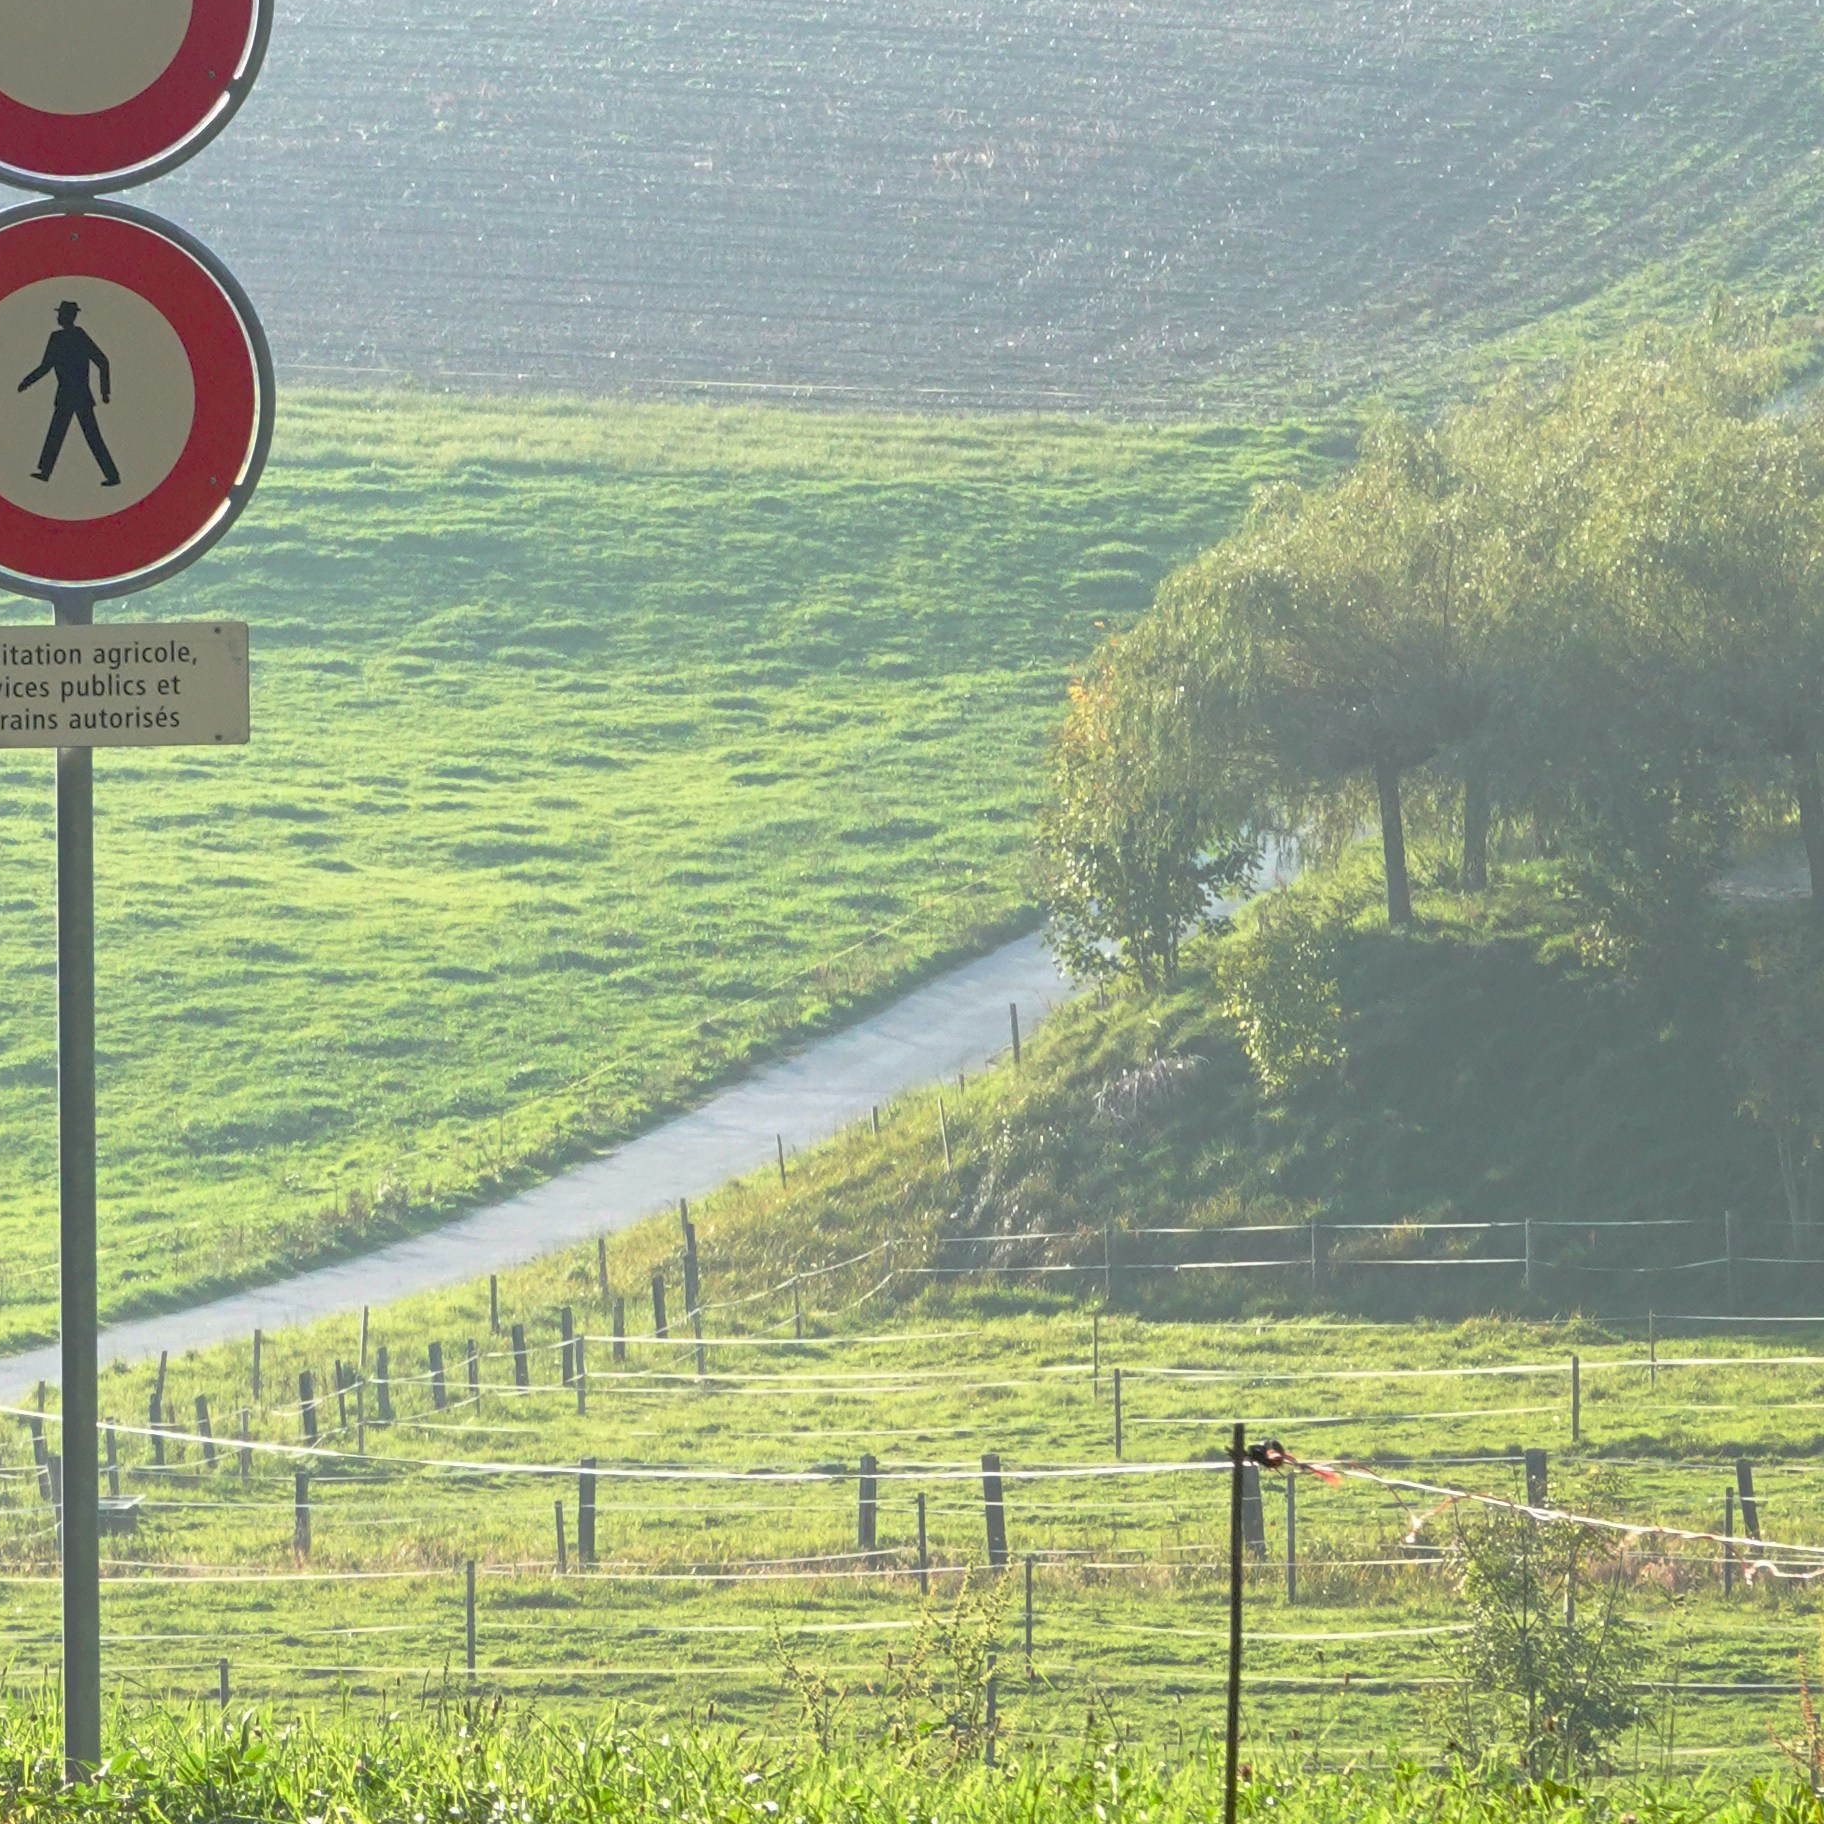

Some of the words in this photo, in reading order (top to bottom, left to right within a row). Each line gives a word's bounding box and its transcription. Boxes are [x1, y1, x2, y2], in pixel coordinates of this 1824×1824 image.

[93, 640, 198, 669] agricole,
[61, 673, 146, 702] publics
[157, 675, 182, 695] et
[68, 705, 180, 729] autorisés
